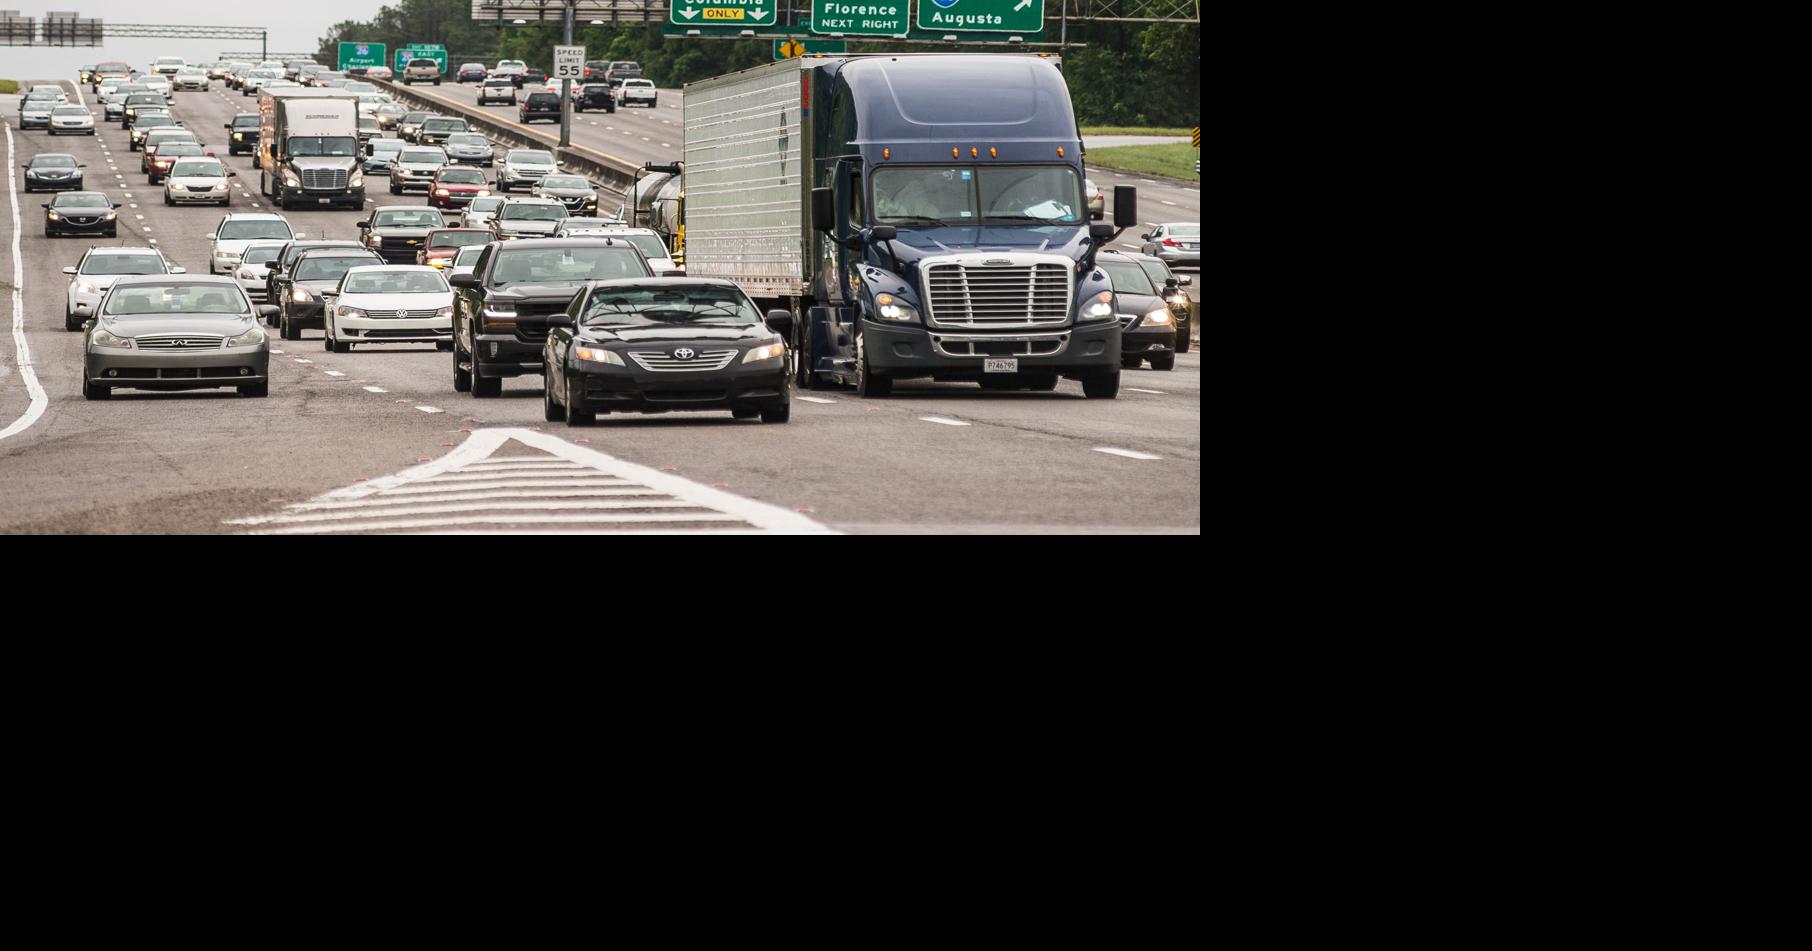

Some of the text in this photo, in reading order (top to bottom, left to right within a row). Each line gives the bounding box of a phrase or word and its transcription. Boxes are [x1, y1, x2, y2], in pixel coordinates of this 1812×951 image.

[706, 9, 740, 18] ONLY
[824, 2, 897, 15] Florence
[821, 19, 899, 29] NEXT RIGHT
[931, 11, 1003, 27] Augusta
[559, 65, 580, 76] 55
